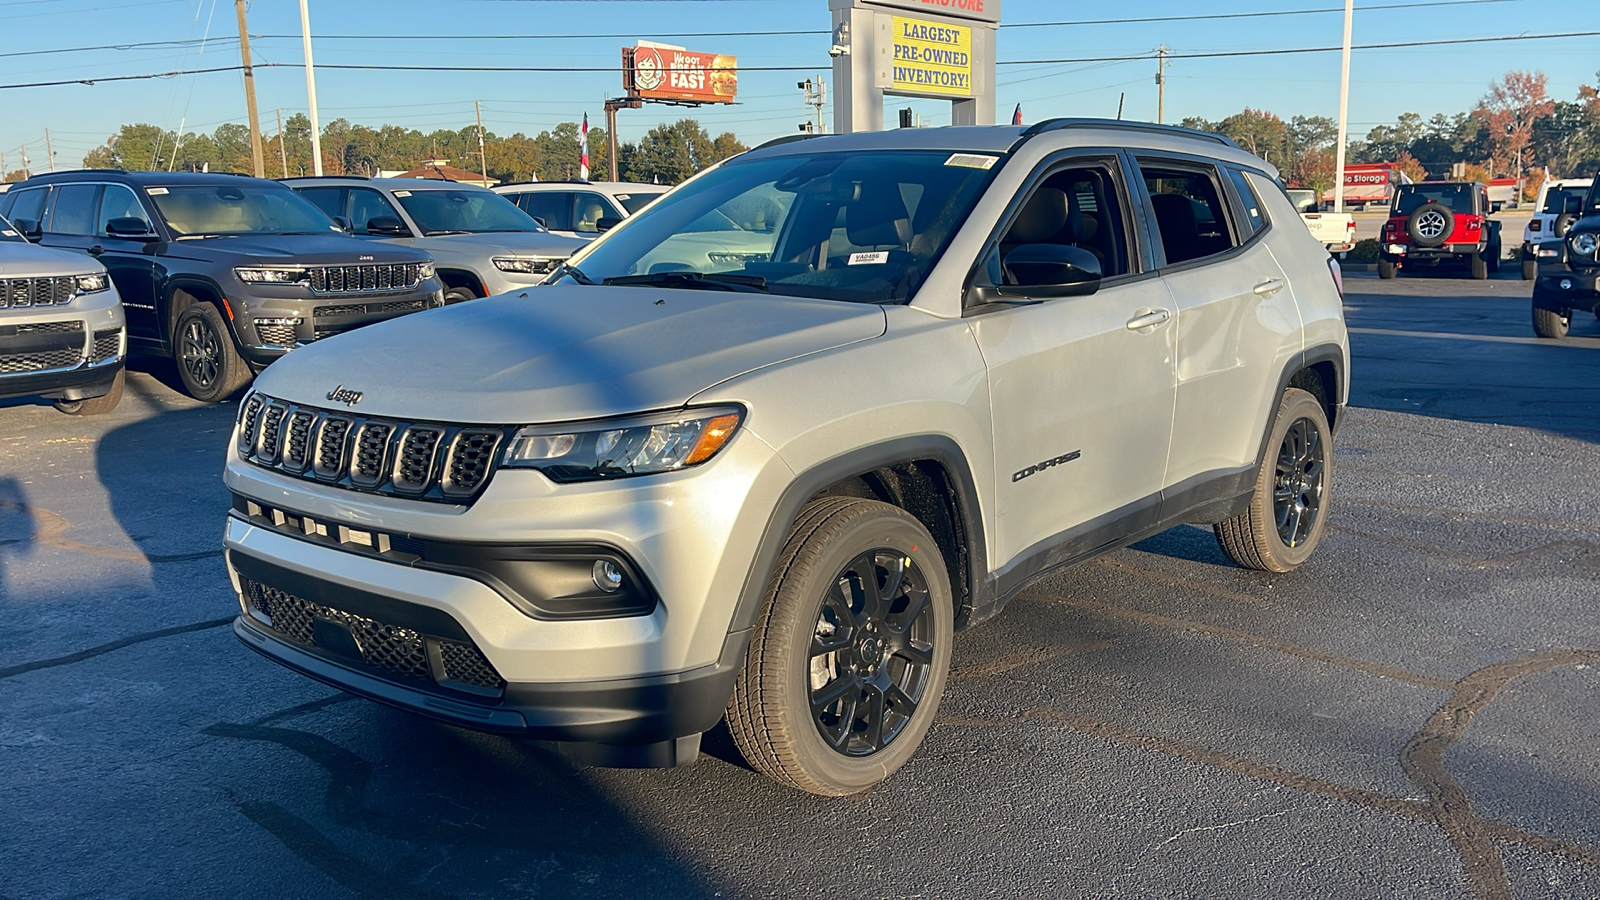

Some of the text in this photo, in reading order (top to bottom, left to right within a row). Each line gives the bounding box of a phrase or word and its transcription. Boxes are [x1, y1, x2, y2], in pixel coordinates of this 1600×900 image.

[903, 22, 960, 43] LARGEST
[893, 44, 968, 66] PRE-OWNED
[670, 73, 705, 89] FAST
[893, 66, 969, 87] INVENTORY!
[1353, 175, 1386, 184] Storage
[326, 384, 364, 407] Jeep
[1012, 449, 1081, 482] COMPASS
